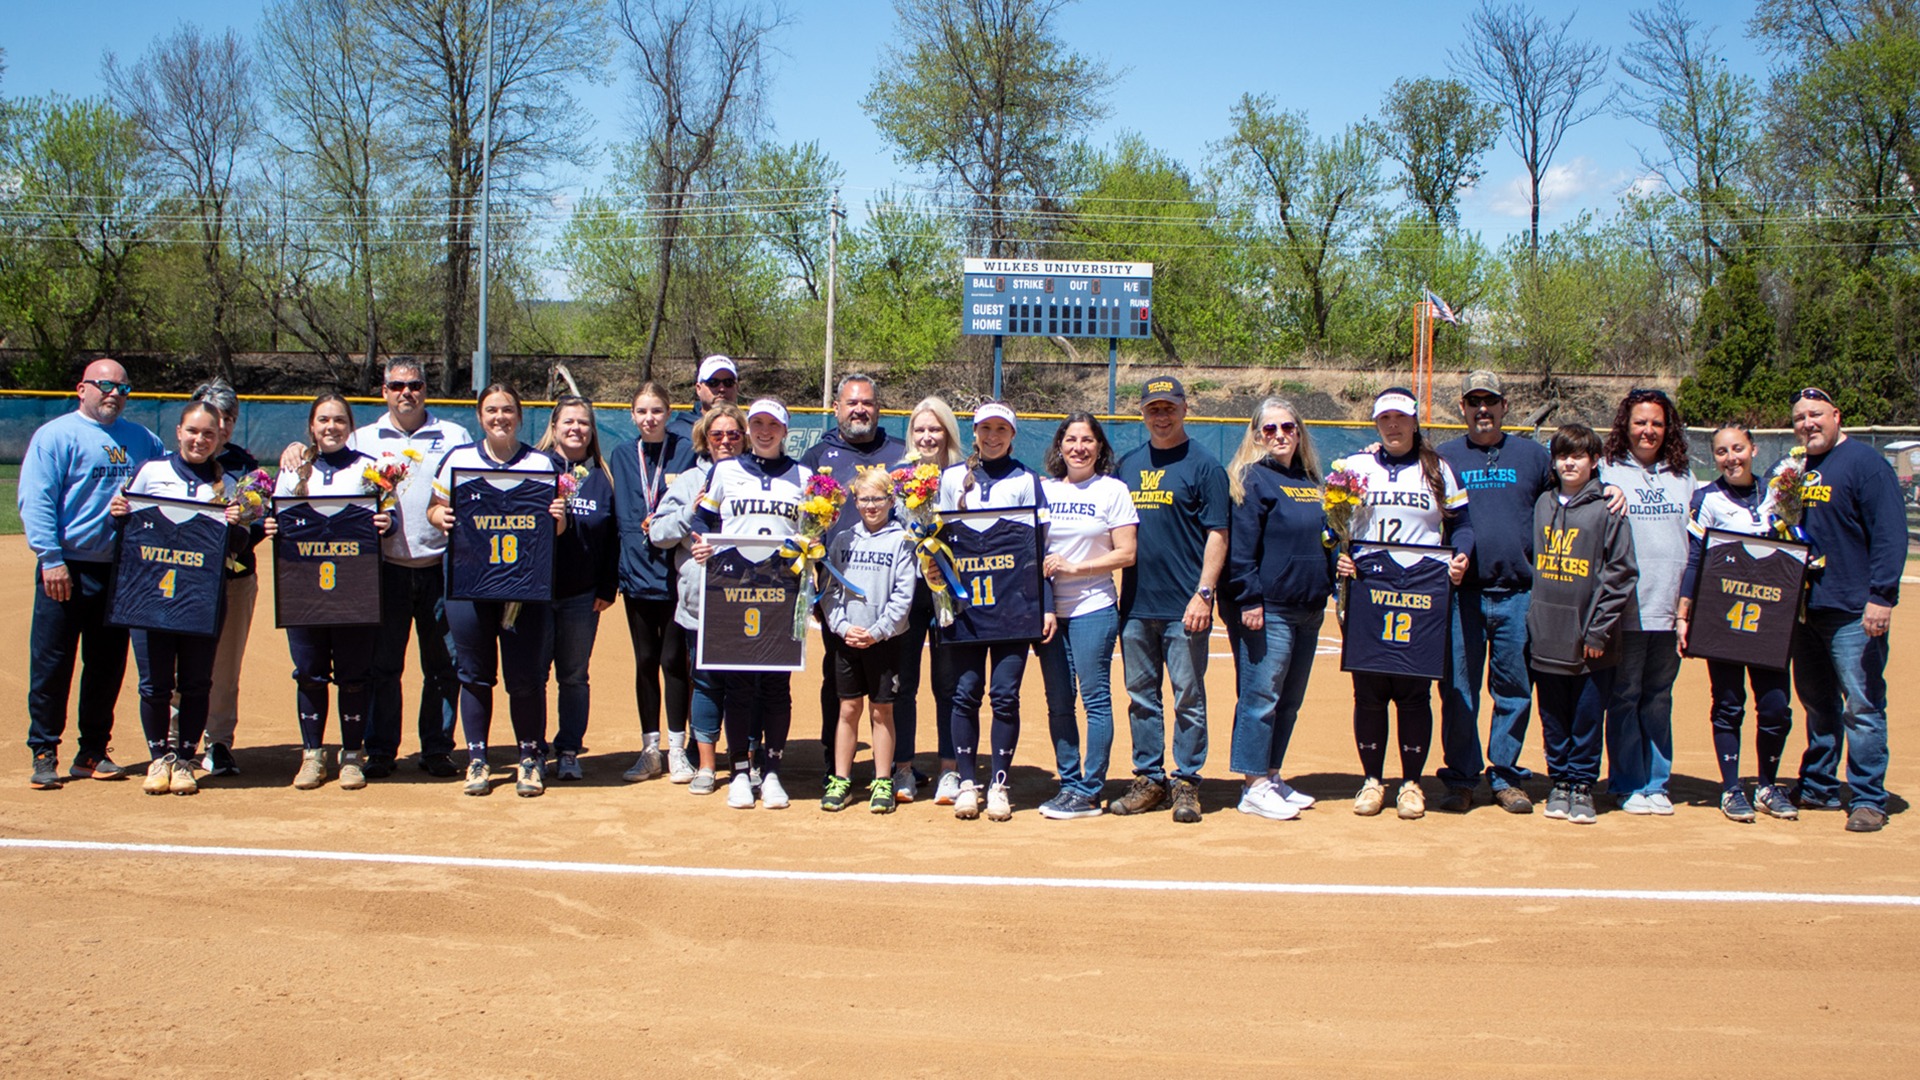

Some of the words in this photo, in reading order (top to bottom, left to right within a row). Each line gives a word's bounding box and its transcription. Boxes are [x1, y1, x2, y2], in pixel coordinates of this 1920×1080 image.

[984, 262, 1039, 272] WILKES
[1044, 263, 1133, 275] UNIVERSITY
[973, 278, 995, 288] BALL
[1013, 279, 1044, 290] STRIKE
[1070, 280, 1088, 291] OUT
[1123, 282, 1139, 292] H/E
[972, 304, 1005, 315] GUEST
[1011, 296, 1016, 304] 1
[1022, 296, 1028, 304] 2
[1035, 296, 1041, 305] 3
[1050, 297, 1056, 305] 4
[1063, 297, 1069, 305] 5
[1075, 297, 1081, 306] 6
[1090, 298, 1096, 306] 7
[1101, 298, 1107, 306] 8
[1113, 298, 1119, 307] 9
[1129, 299, 1150, 307] RUNS
[972, 319, 1002, 330] HOME
[102, 445, 127, 464] W
[1140, 470, 1166, 490] W
[1634, 488, 1665, 503] W
[730, 499, 799, 522] WILKES
[474, 515, 536, 530] WILKES
[1378, 518, 1402, 543] 12
[297, 541, 360, 556] WILKES
[489, 534, 518, 564] 18
[1544, 525, 1580, 555] W
[140, 545, 205, 568] WILKES
[840, 549, 894, 567] WILKES
[953, 554, 1015, 573] WILKES
[158, 568, 177, 599] 4
[319, 561, 336, 590] 8
[723, 587, 786, 603] WILKES
[970, 575, 996, 607] 11
[1370, 588, 1432, 610] WILKES
[1721, 578, 1782, 602] WILKES
[744, 607, 761, 637] 9
[1726, 600, 1762, 633] 42
[1381, 610, 1412, 643] 12
